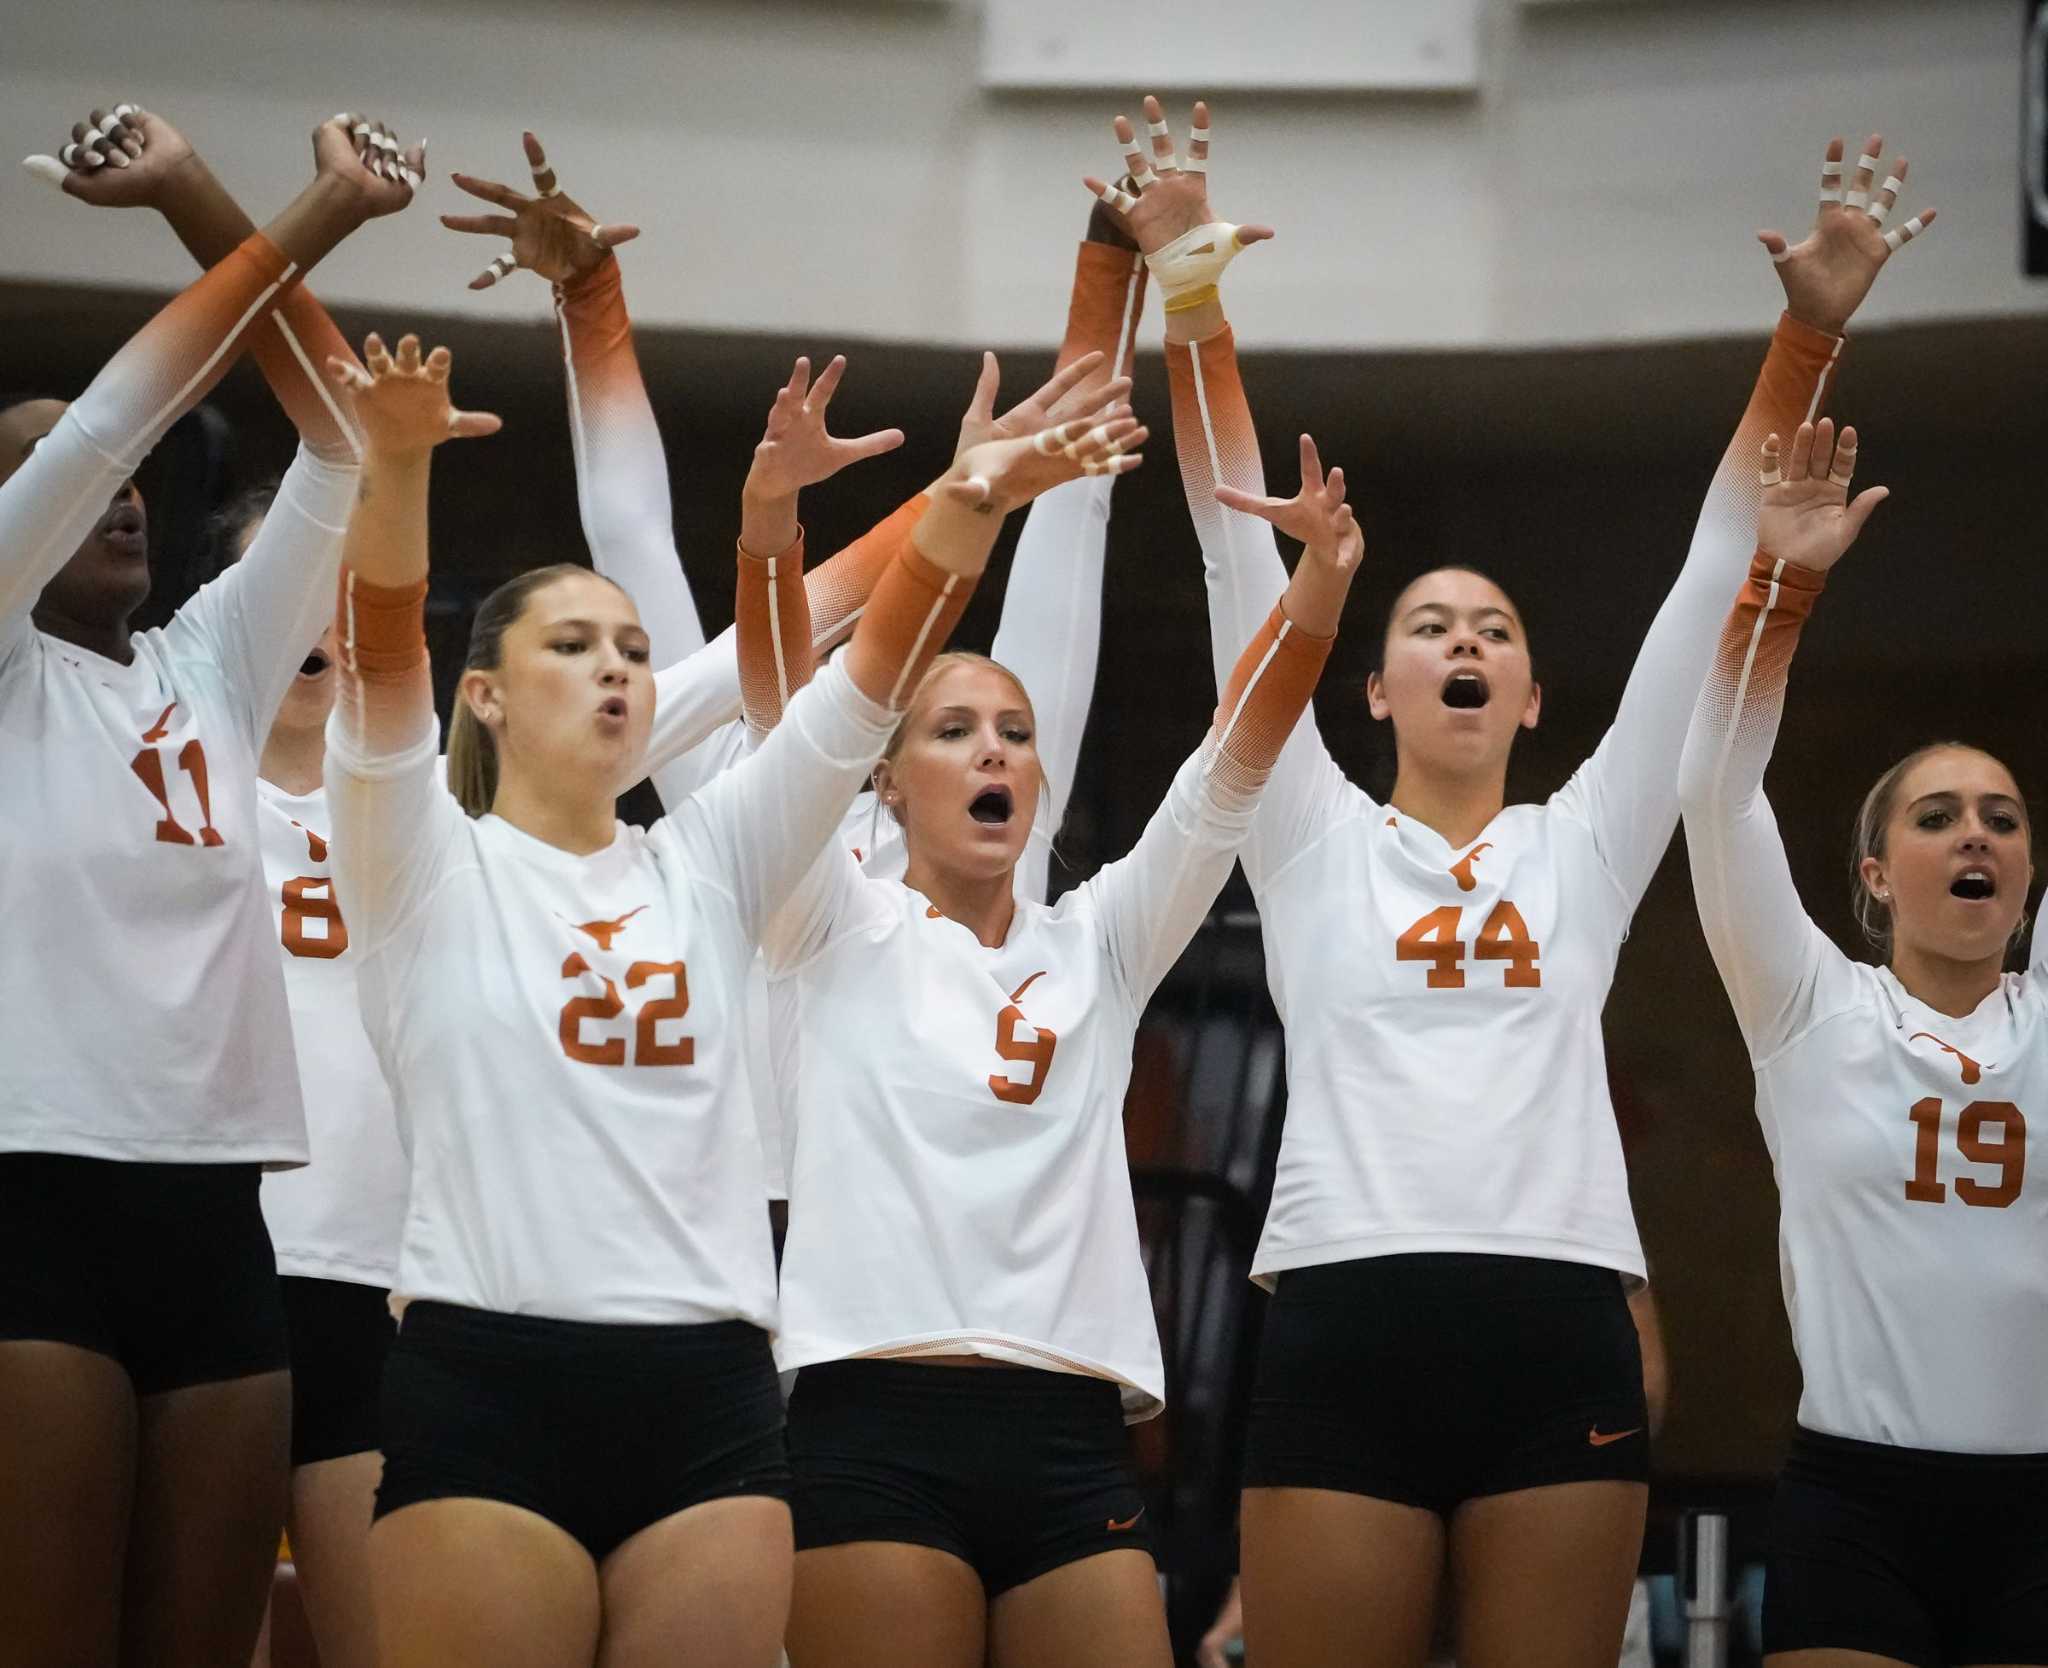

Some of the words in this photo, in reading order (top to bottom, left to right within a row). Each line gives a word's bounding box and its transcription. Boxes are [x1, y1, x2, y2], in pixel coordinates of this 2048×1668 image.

[132, 740, 225, 847] 11
[1396, 900, 1541, 989] 44
[560, 952, 694, 1066] 22
[988, 1005, 1057, 1105] 9
[1905, 1097, 2026, 1208] 19
